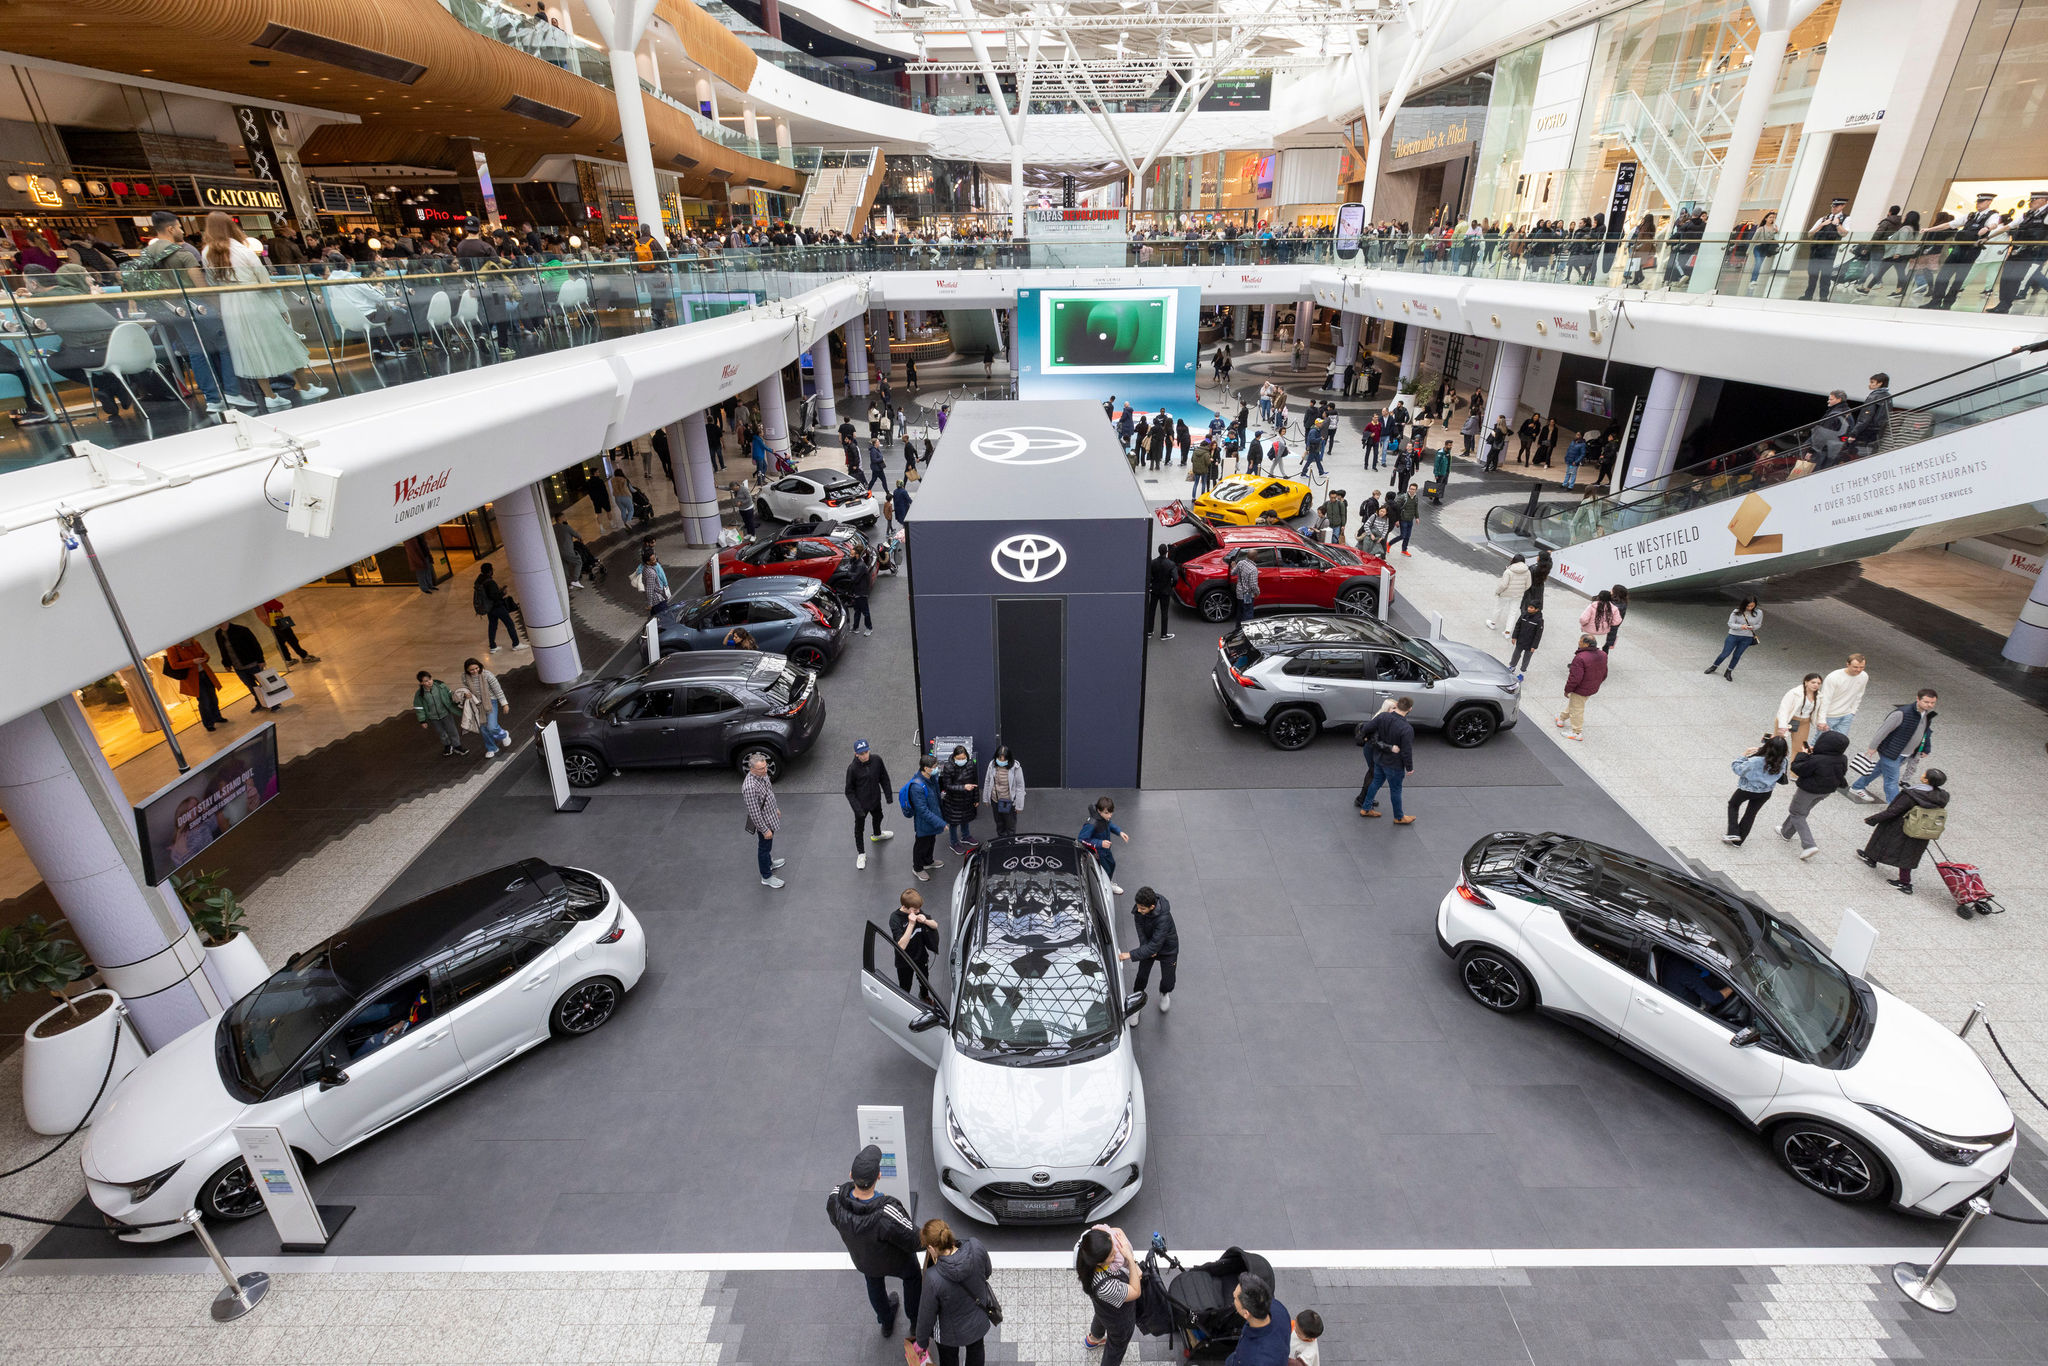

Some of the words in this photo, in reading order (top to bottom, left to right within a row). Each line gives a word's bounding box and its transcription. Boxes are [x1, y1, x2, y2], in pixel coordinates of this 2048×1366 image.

[1871, 112, 1876, 120] 2
[1395, 128, 1437, 158] Abercrombie
[1447, 118, 1468, 145] Fitch
[1619, 171, 1625, 180] 2
[207, 188, 258, 207] CATCH
[261, 190, 282, 208] ME
[425, 208, 449, 220] Pho
[1553, 316, 1578, 331] Westfield
[1831, 482, 1844, 494] LET
[1848, 476, 1870, 489] THEM
[1871, 469, 1896, 483] SPOIL
[1899, 451, 1958, 475] THEMSELVES
[393, 466, 454, 508] Westfield
[1813, 503, 1822, 514] AT
[1824, 497, 1845, 511] OVER
[1846, 493, 1861, 506] 350
[1863, 484, 1896, 501] STORES
[1898, 479, 1916, 492] AND
[1918, 460, 1988, 488] RESTAURANTS
[394, 502, 426, 524] LONDON
[427, 496, 441, 510] W12
[1831, 512, 1861, 527] AVAILABLE
[1862, 508, 1884, 520] ONLINE
[1885, 504, 1898, 514] AND
[1899, 500, 1917, 511] FROM
[1917, 494, 1939, 507] GUEST
[1940, 486, 1974, 501] SERVICES
[1614, 543, 1634, 561] THE
[1636, 525, 1700, 555] WESTFIELD
[1560, 563, 1585, 584] Westfield
[1629, 558, 1653, 577] GIFT
[1656, 550, 1689, 572] CARD
[197, 794, 214, 814] STAY
[222, 776, 241, 797] STAND
